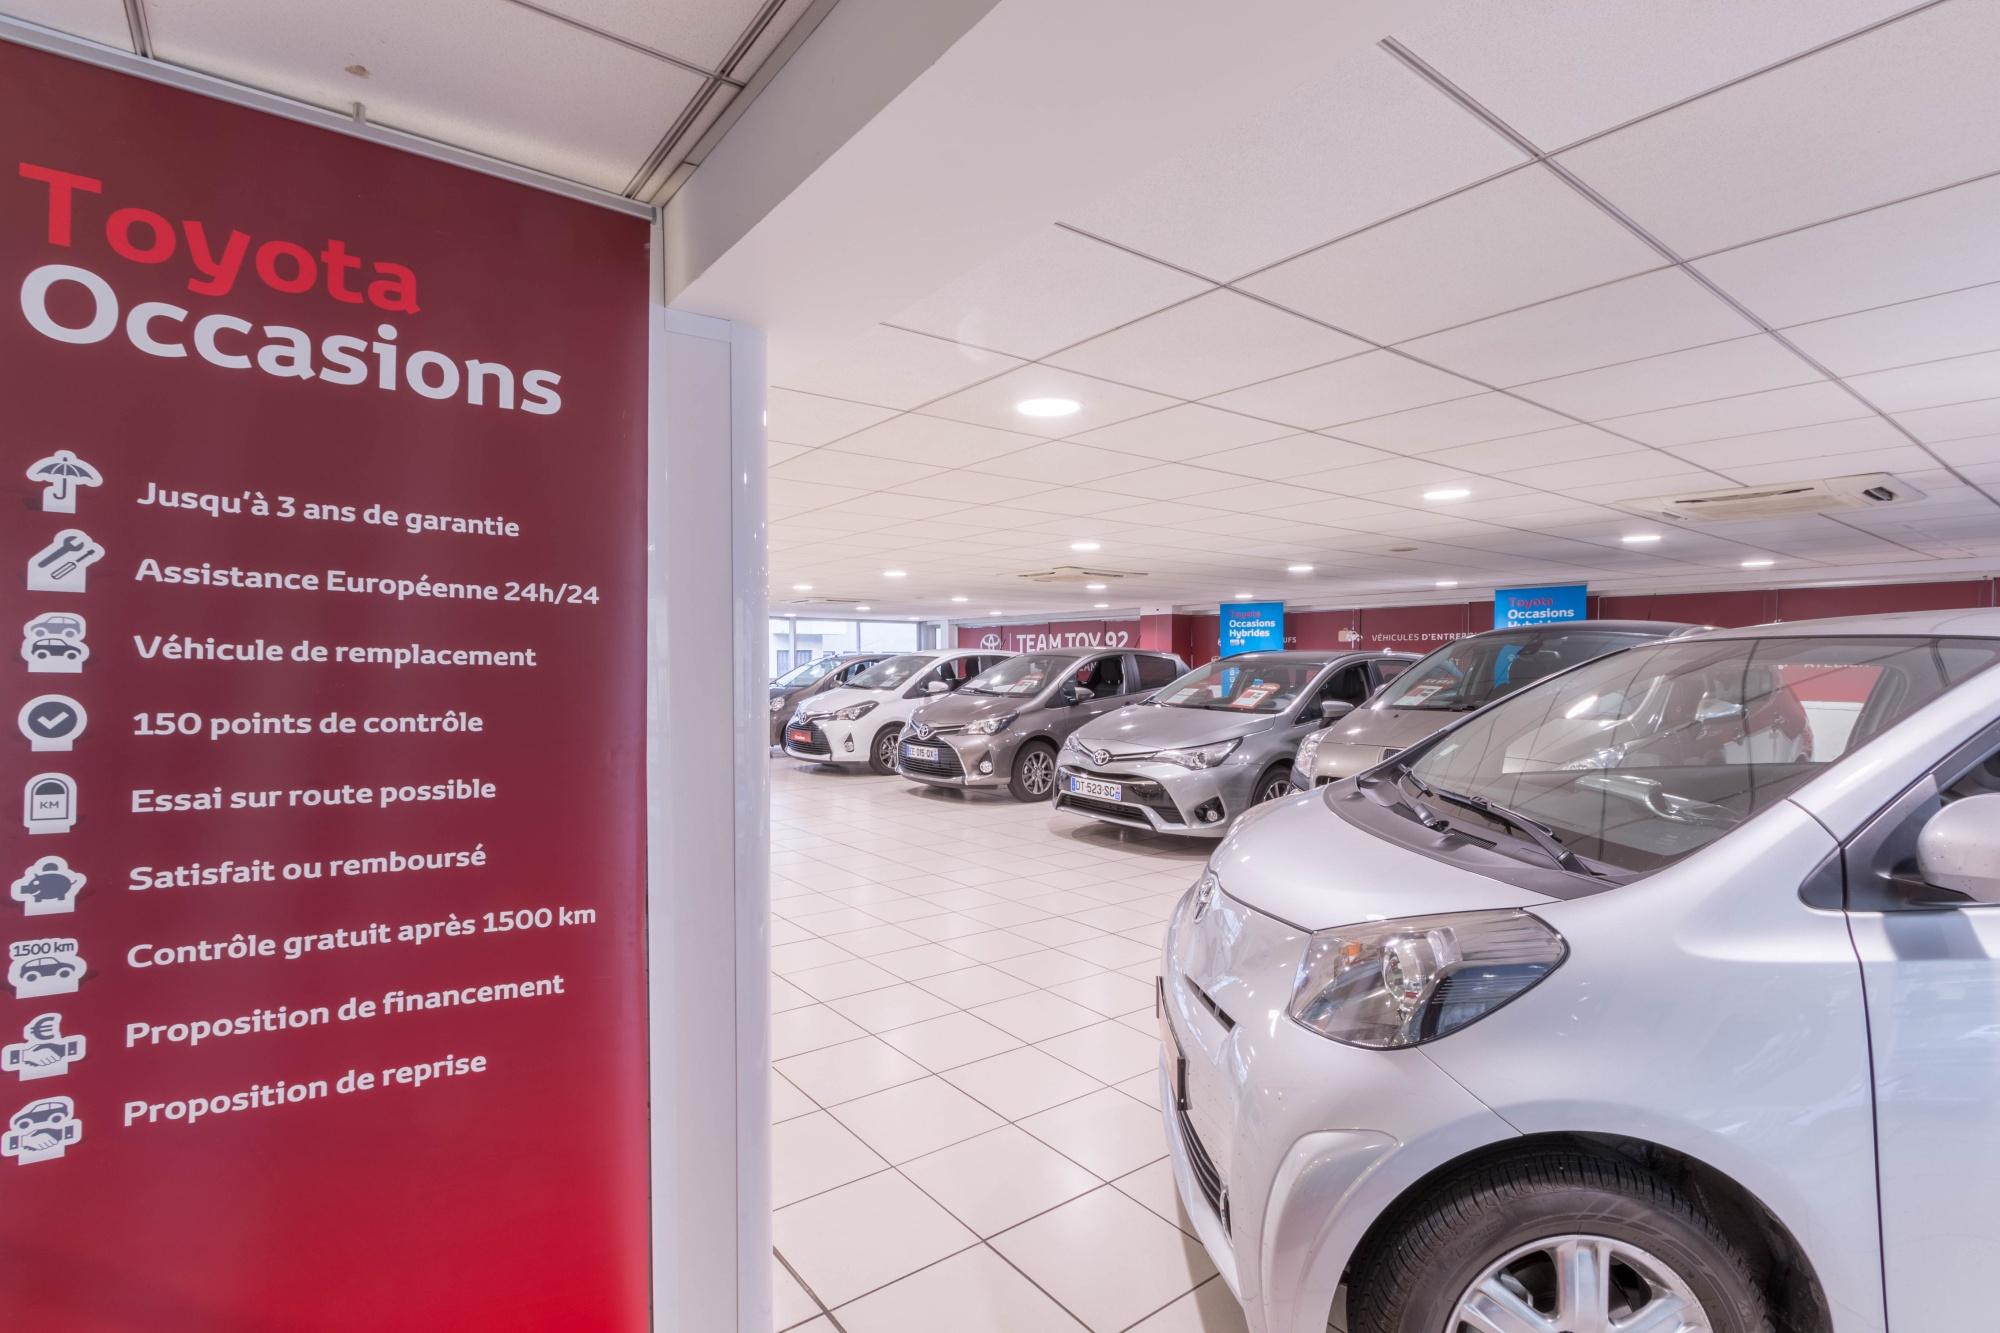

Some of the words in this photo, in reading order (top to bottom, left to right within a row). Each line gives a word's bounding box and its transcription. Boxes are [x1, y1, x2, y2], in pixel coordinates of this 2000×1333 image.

[19, 163, 420, 314] Toyota
[20, 264, 562, 415] Occasions
[136, 482, 270, 518] Jusqu'à
[276, 495, 296, 518] 3
[303, 503, 356, 522] ans
[363, 503, 399, 526] de
[405, 512, 520, 537] garantie
[135, 558, 319, 591] Assistance
[327, 570, 498, 601] Européenne
[504, 581, 600, 605] 24h/24
[1229, 619, 1276, 628] Occasions
[1507, 608, 1575, 619] Occasions
[1016, 633, 1061, 653] TEAM
[1104, 630, 1129, 647] 92
[1229, 628, 1271, 638] Hybrides
[1371, 633, 1420, 642] VÉHICULES
[133, 634, 284, 662] Véhicule
[290, 640, 328, 662] de
[335, 643, 537, 669] remplacement
[133, 712, 202, 736] 150
[210, 712, 312, 741] points
[319, 712, 357, 734] de
[363, 710, 483, 733] contrôle
[39, 800, 60, 809] KM
[132, 786, 222, 813] Essai
[230, 790, 283, 809] sur
[289, 784, 373, 806] route
[380, 778, 496, 809] possible
[128, 859, 276, 891] Satisfait
[282, 862, 322, 880] ou
[329, 843, 486, 877] remboursé
[13, 942, 51, 957] 1500
[53, 941, 75, 953] km
[127, 933, 276, 968] Contrôle
[283, 922, 392, 960] gratuit
[397, 913, 476, 945] après
[482, 907, 553, 933] 1500
[559, 906, 596, 926] km
[126, 1006, 329, 1048] Proposition
[337, 997, 377, 1021] de
[382, 975, 565, 1015] financement
[124, 1080, 328, 1127] Proposition
[336, 1069, 375, 1094] de
[382, 1054, 487, 1088] reprise
